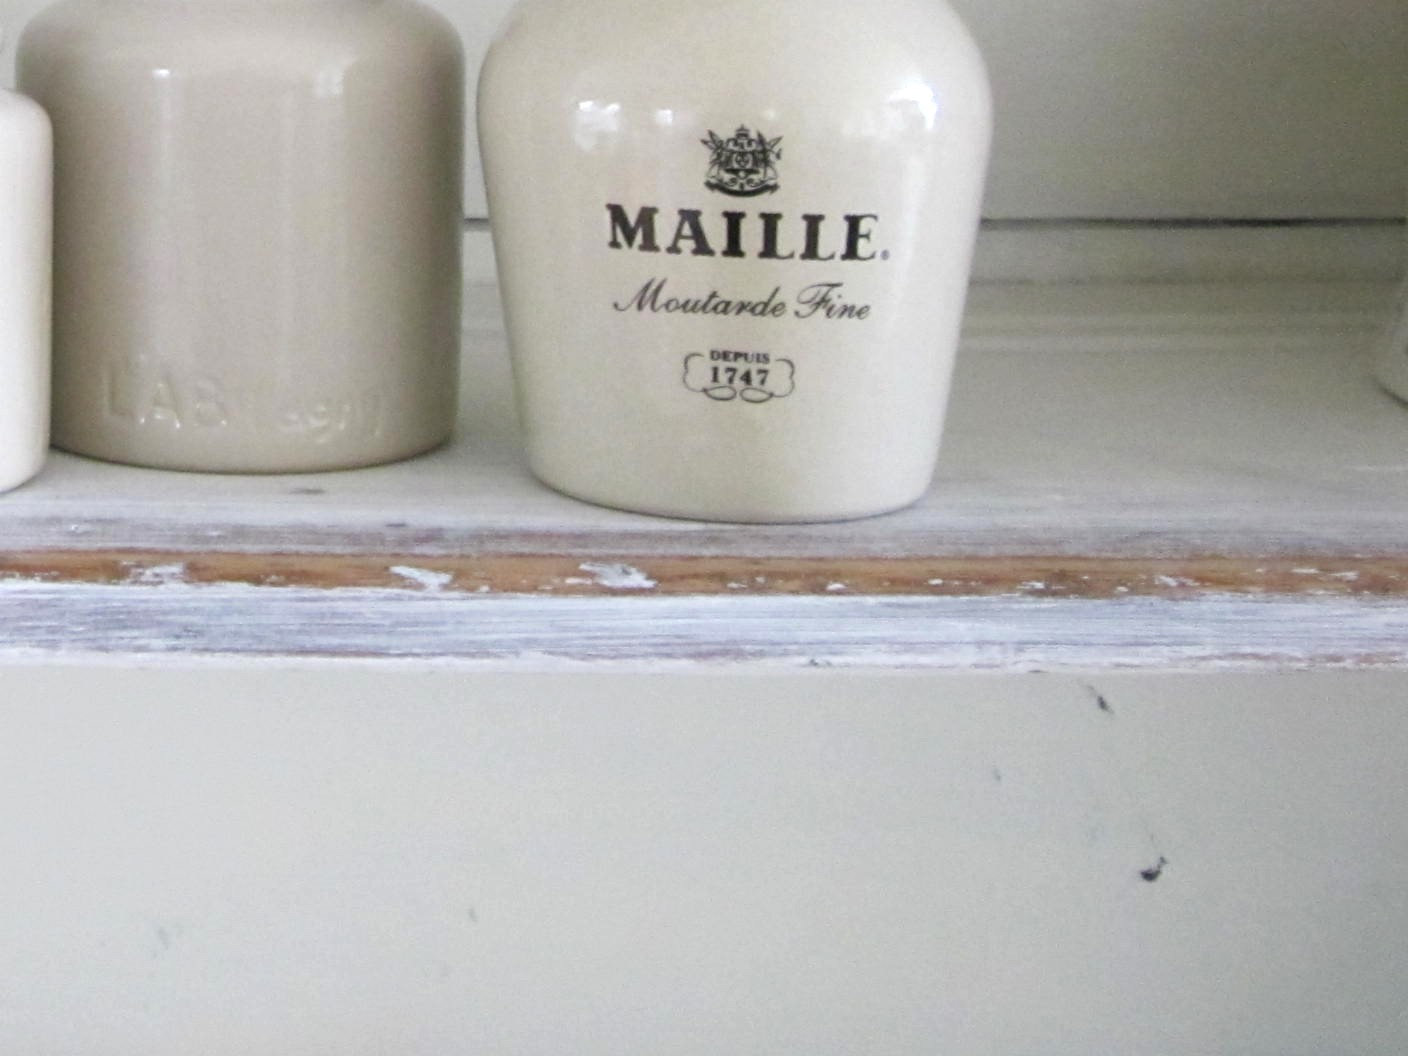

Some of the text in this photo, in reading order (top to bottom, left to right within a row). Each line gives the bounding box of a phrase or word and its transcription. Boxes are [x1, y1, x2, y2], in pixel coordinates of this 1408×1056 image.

[605, 203, 879, 261] MAILLE
[612, 277, 872, 321] Moutarde Fine
[709, 350, 771, 365] DEPUIS
[711, 365, 770, 386] 1747
